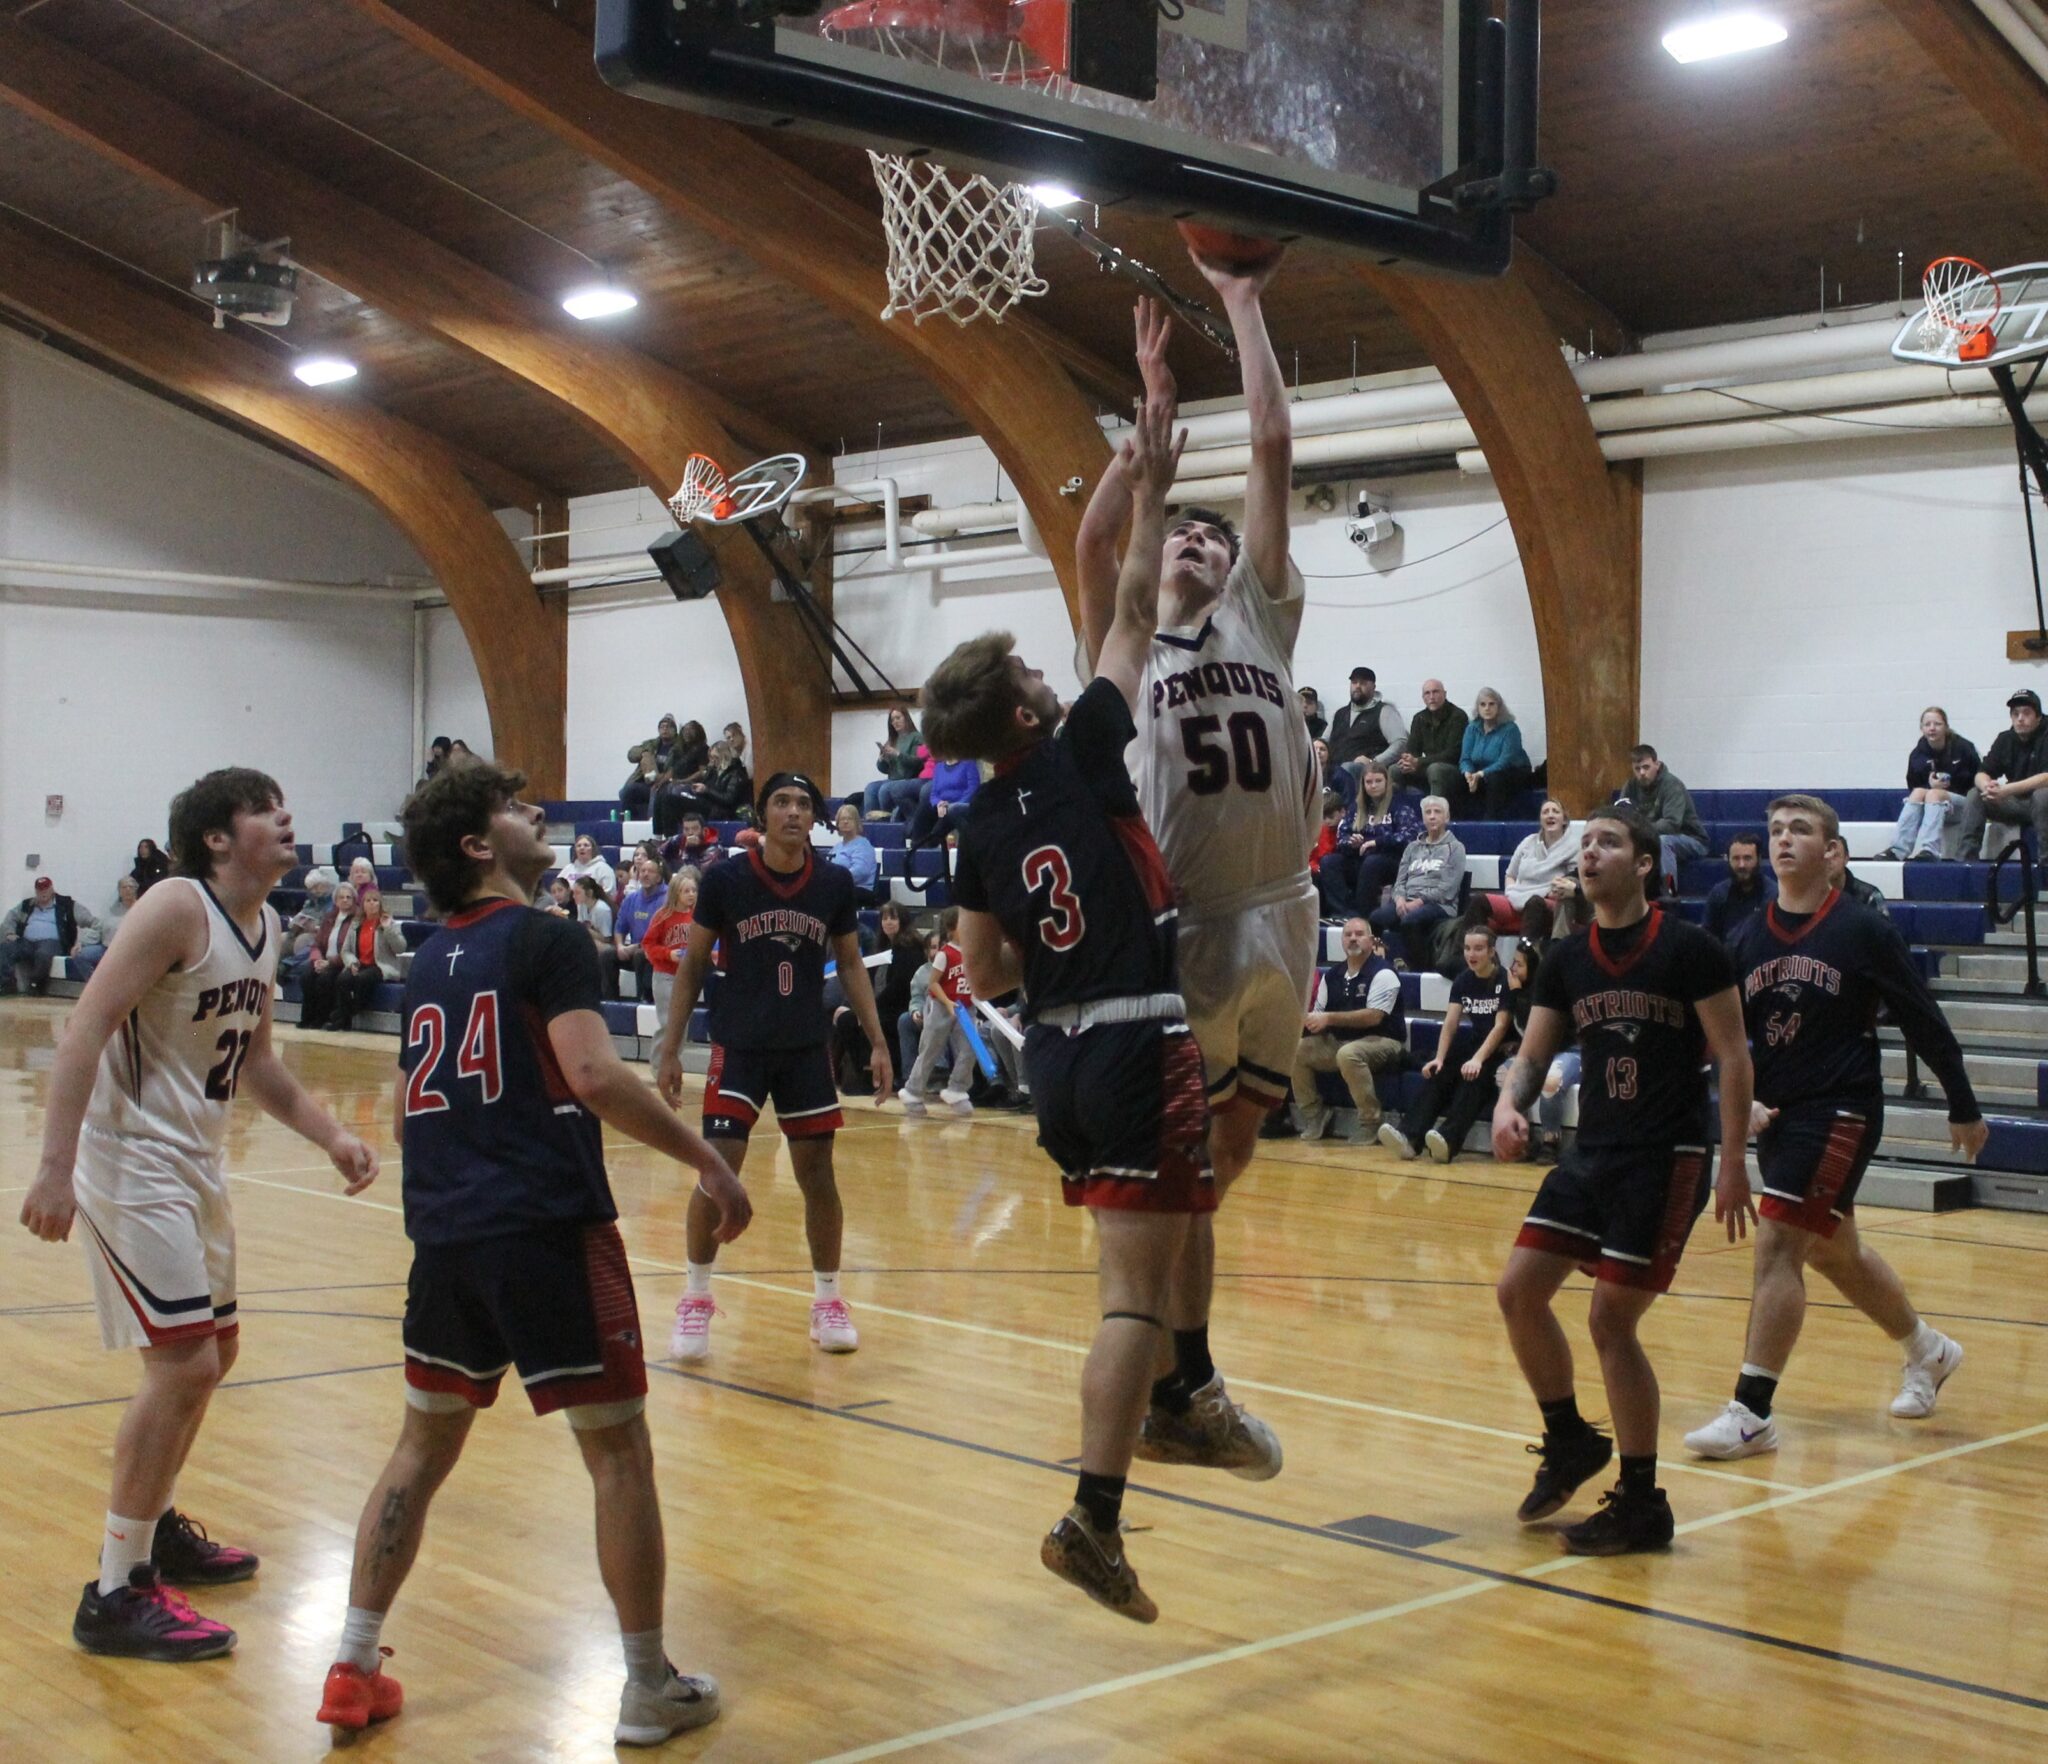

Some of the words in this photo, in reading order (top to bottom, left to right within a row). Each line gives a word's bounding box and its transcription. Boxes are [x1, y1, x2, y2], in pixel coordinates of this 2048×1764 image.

[1153, 661, 1285, 719] PENQUIS
[1179, 711, 1272, 796] 50
[1021, 844, 1086, 952] 3
[736, 909, 828, 947] PATRIOTS
[778, 960, 793, 996] 0
[405, 990, 503, 1118] 24
[1766, 1011, 1802, 1046] 54
[1605, 1056, 1638, 1100] 13
